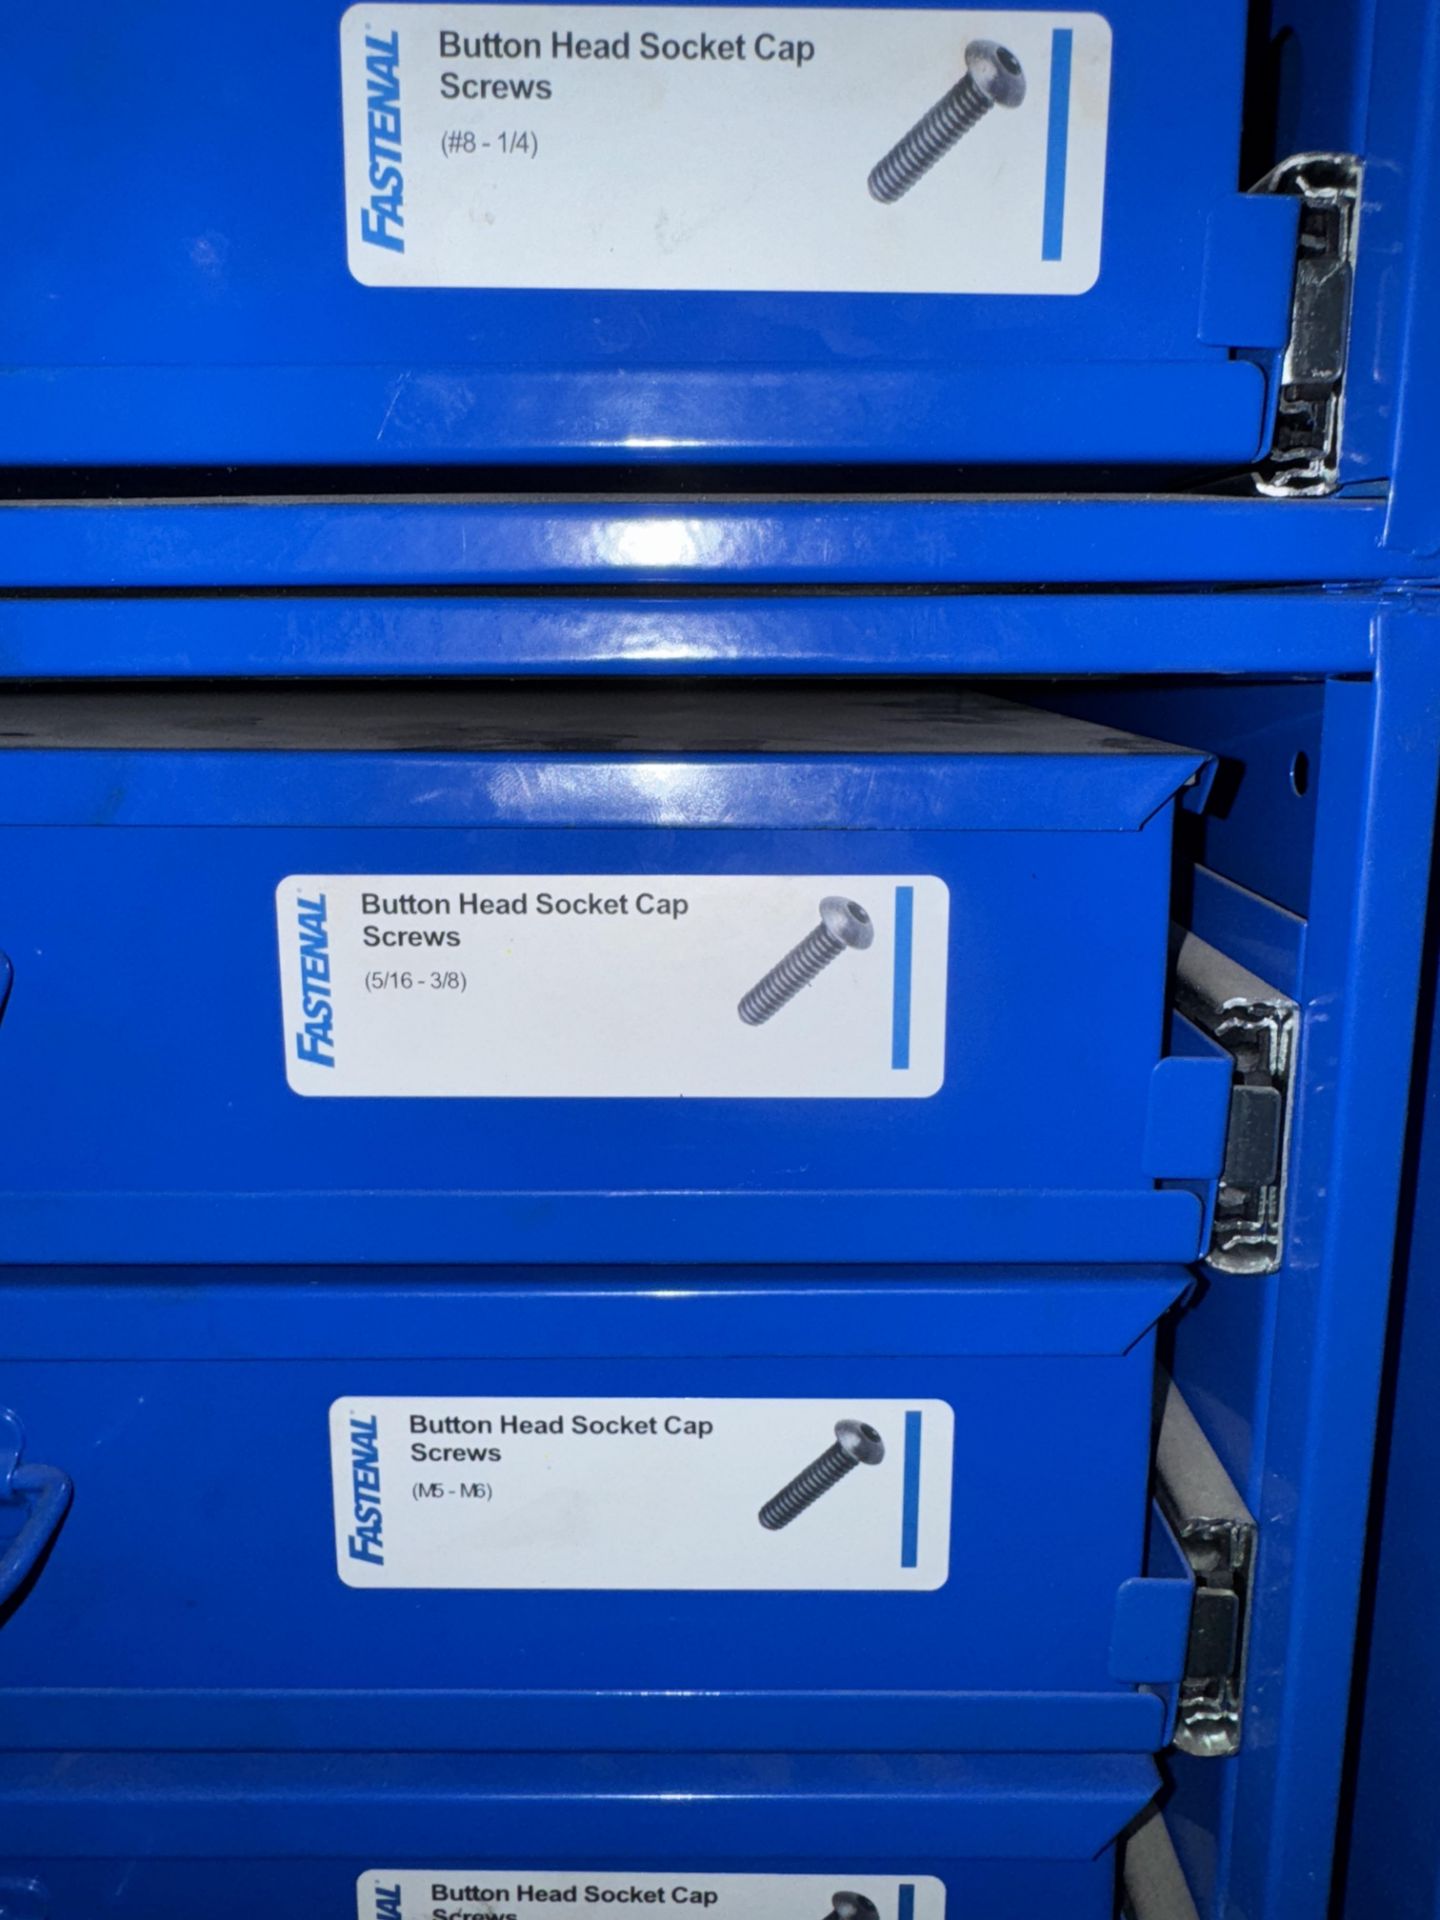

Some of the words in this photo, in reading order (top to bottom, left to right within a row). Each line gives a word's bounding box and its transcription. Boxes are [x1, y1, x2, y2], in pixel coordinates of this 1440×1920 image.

[440, 30, 541, 59] Button
[552, 31, 630, 60] Head
[639, 32, 746, 61] Socket
[755, 32, 815, 68] Cap
[440, 72, 553, 100] Screws
[361, 29, 404, 253] FASTENAL
[441, 130, 477, 159] (#8
[498, 130, 538, 160] 1/4)
[361, 892, 451, 915] Button
[459, 893, 528, 915] Head
[535, 893, 629, 915] Socket
[635, 893, 689, 920] Cap
[363, 925, 461, 948] Screws
[296, 893, 335, 1068] FASTENAL
[365, 971, 413, 993] (5/16
[430, 971, 467, 993] 3/8)
[409, 1414, 493, 1435] Button
[500, 1415, 564, 1435] Head
[571, 1415, 658, 1435] Socket
[663, 1415, 714, 1440] Cap
[410, 1442, 502, 1462] Screws
[348, 1414, 385, 1566] FASTENAL
[412, 1482, 445, 1500] (M5
[460, 1482, 493, 1500] M6)
[431, 1883, 510, 1902] Button
[516, 1884, 578, 1903] Head
[584, 1885, 666, 1904] Socket
[671, 1886, 719, 1908] Cap
